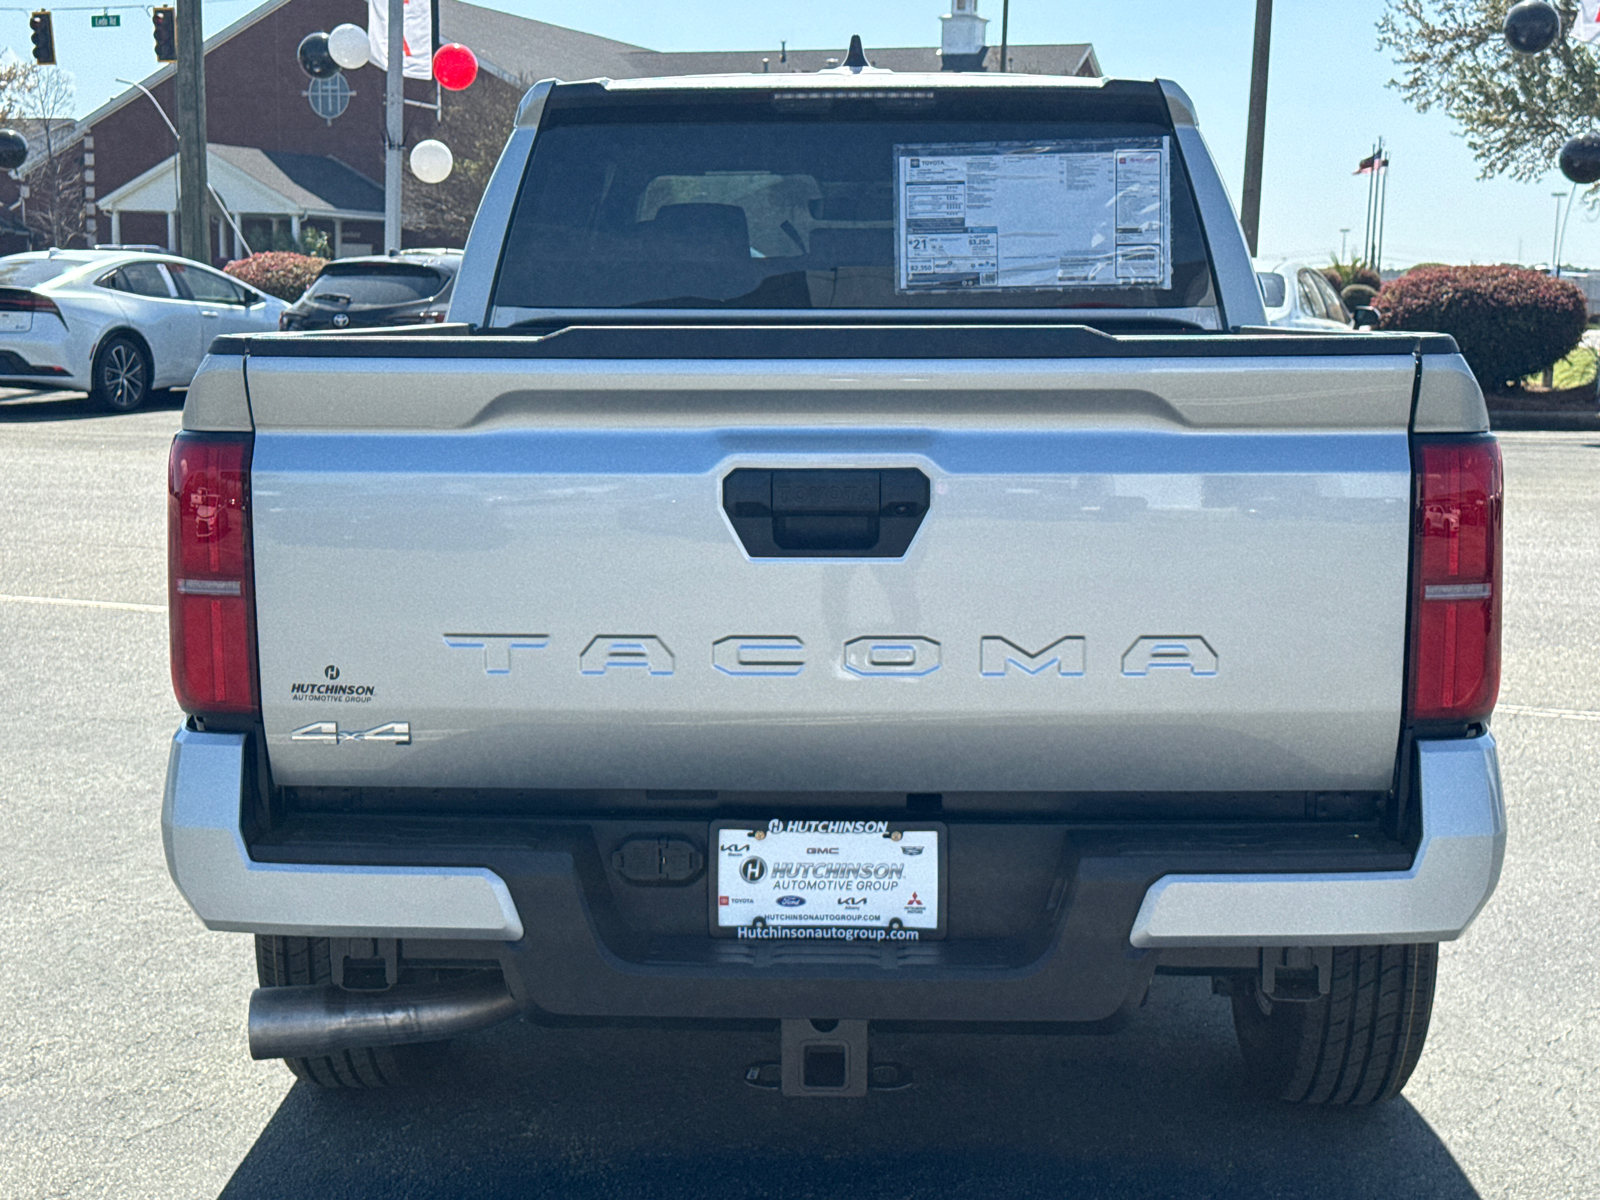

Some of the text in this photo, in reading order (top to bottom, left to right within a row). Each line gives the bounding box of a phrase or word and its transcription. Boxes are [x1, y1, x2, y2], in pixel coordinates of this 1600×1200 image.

[913, 239, 927, 250] 21
[910, 264, 932, 272] $2,350
[778, 485, 874, 504] TOYOTA
[442, 633, 1219, 676] TACOMA
[291, 683, 375, 696] HUTCHINSON
[292, 694, 343, 702] AUTOMOTIVE
[291, 721, 412, 745] 4x4
[787, 820, 889, 833] HUTCHINSON
[806, 847, 840, 855] GMC
[771, 862, 905, 880] HUTCHINSON
[773, 880, 899, 891] AUTOMOTIVE GROUP
[780, 896, 801, 905] Ford
[737, 927, 920, 941] Hutchinsonautogroup.com
